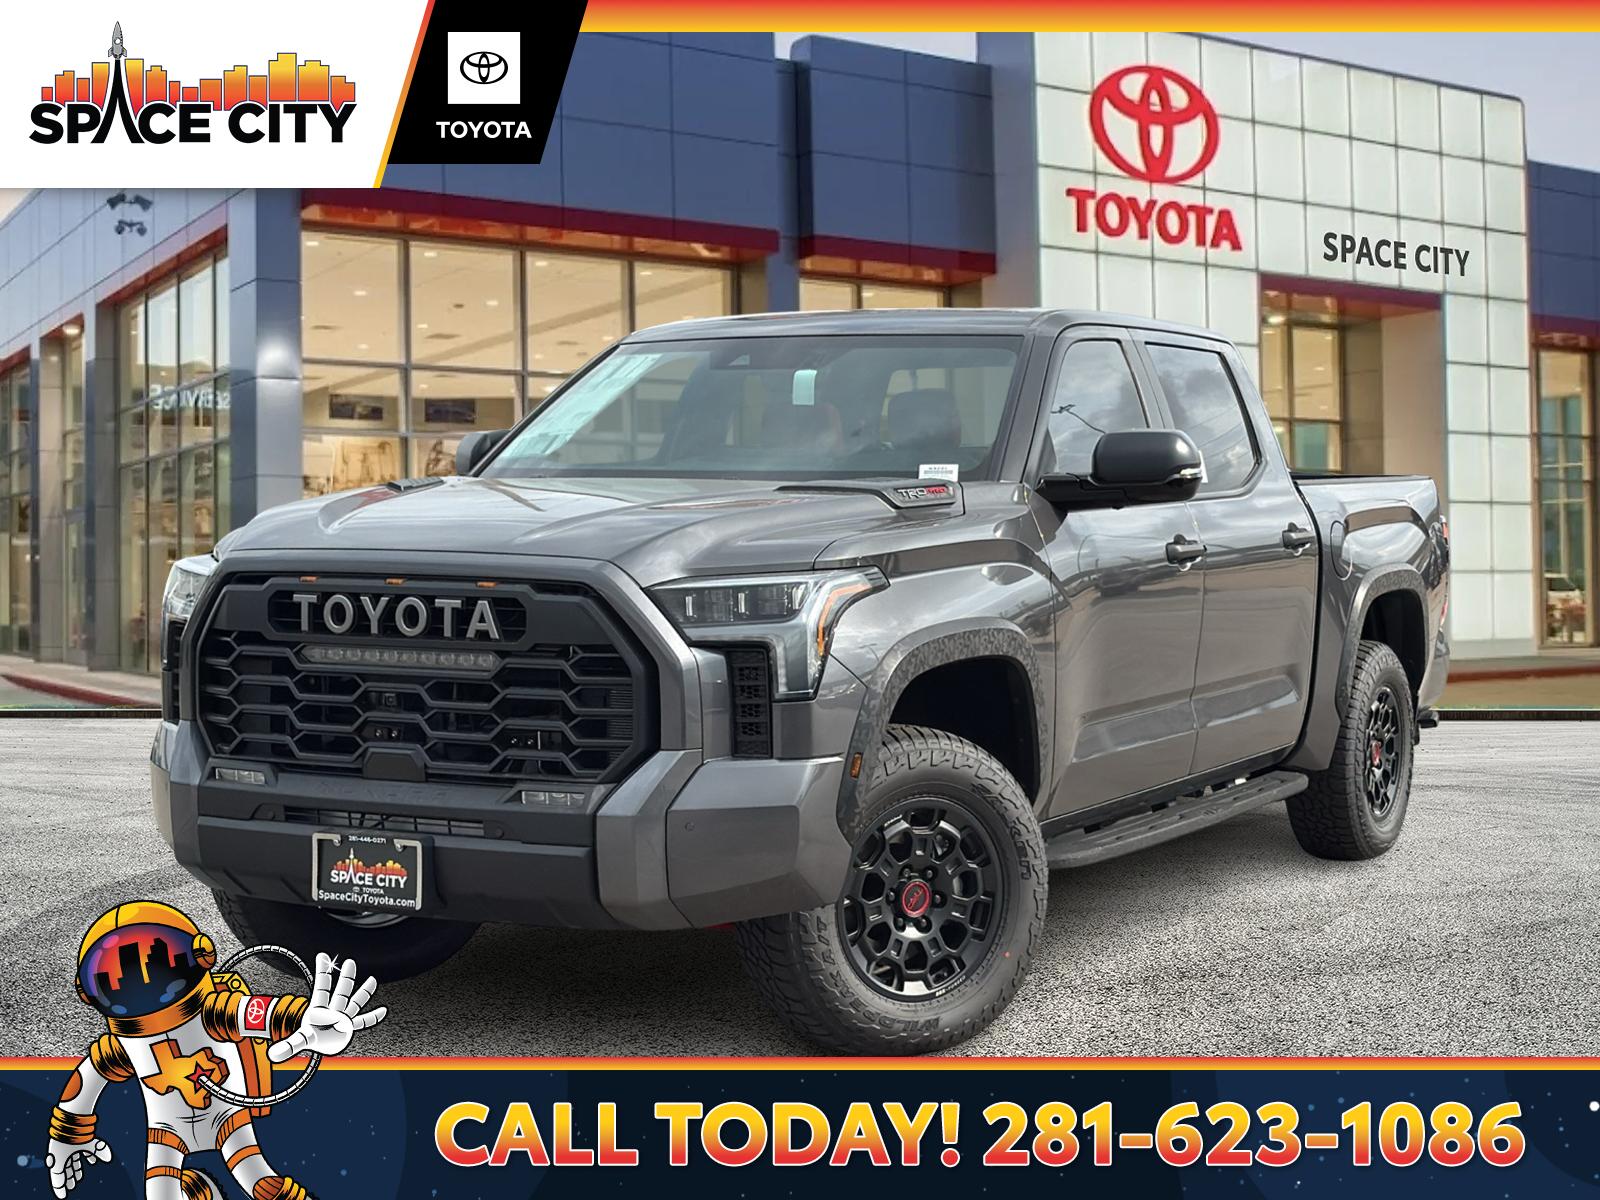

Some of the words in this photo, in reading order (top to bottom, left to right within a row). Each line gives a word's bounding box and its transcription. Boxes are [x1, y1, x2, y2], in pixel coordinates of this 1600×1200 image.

[1065, 187, 1243, 251] TOYOTA
[1322, 231, 1408, 270] SPACE
[1414, 243, 1471, 277] CITY
[292, 593, 502, 641] TOYOTA
[330, 865, 373, 886] SPACE
[375, 874, 408, 889] CITY
[362, 886, 385, 895] TOYOTA
[319, 889, 416, 908] SpaceCityToyota.com
